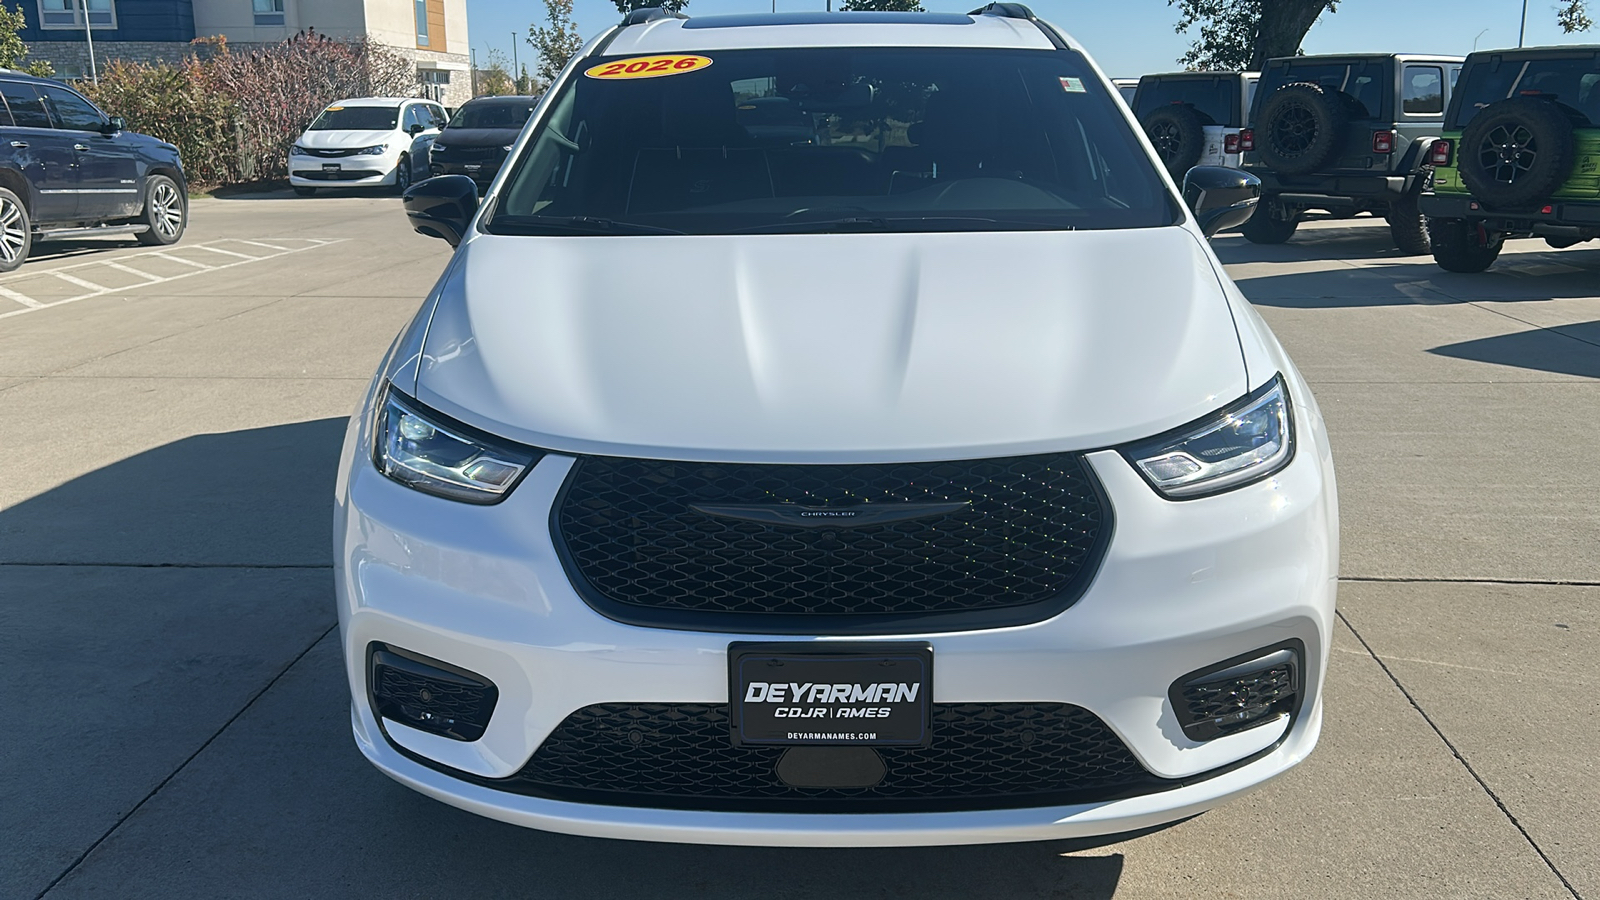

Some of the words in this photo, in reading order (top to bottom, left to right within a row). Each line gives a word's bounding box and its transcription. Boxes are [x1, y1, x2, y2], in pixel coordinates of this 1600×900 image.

[598, 58, 699, 76] 2026
[744, 682, 920, 703] DEYARMAN
[774, 707, 827, 718] CDJR
[836, 707, 891, 718] AMES
[787, 732, 877, 740] DEYARMANAMES.COM
